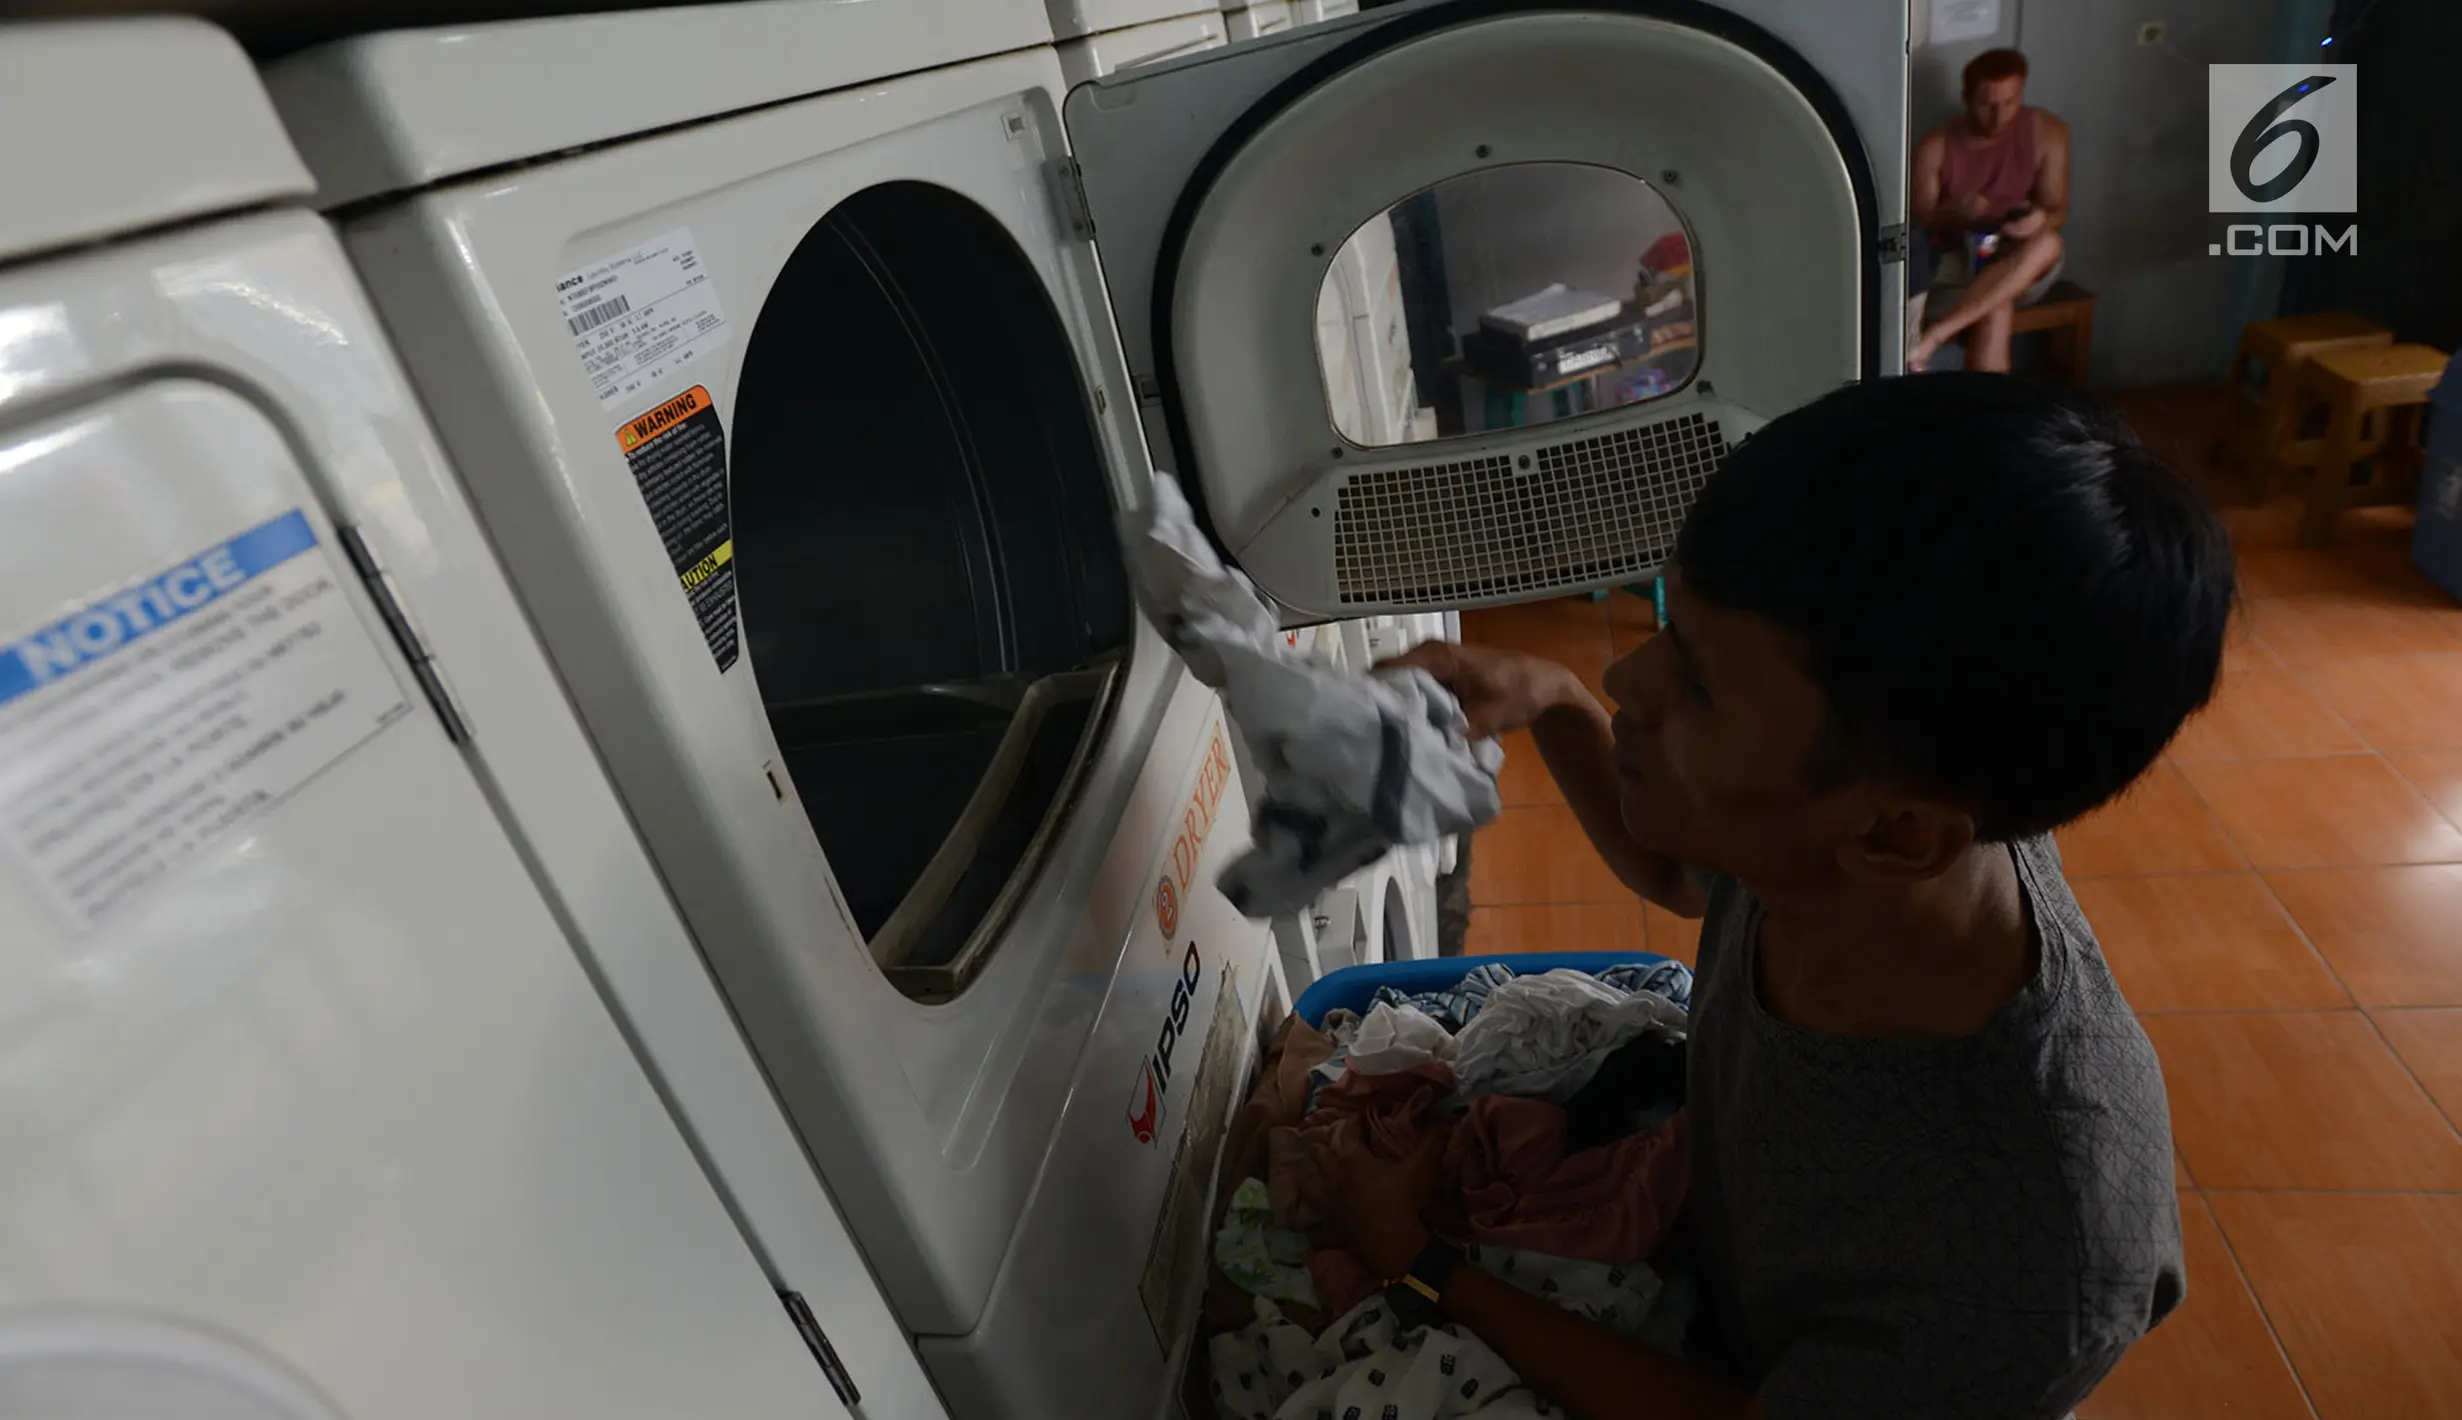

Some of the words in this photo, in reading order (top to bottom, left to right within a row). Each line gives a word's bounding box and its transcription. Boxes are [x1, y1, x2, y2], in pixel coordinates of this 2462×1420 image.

[633, 393, 697, 438] WARNING
[17, 545, 246, 682] NOTICE
[1173, 737, 1228, 896] DRYER
[1153, 940, 1201, 1095] IPSO
